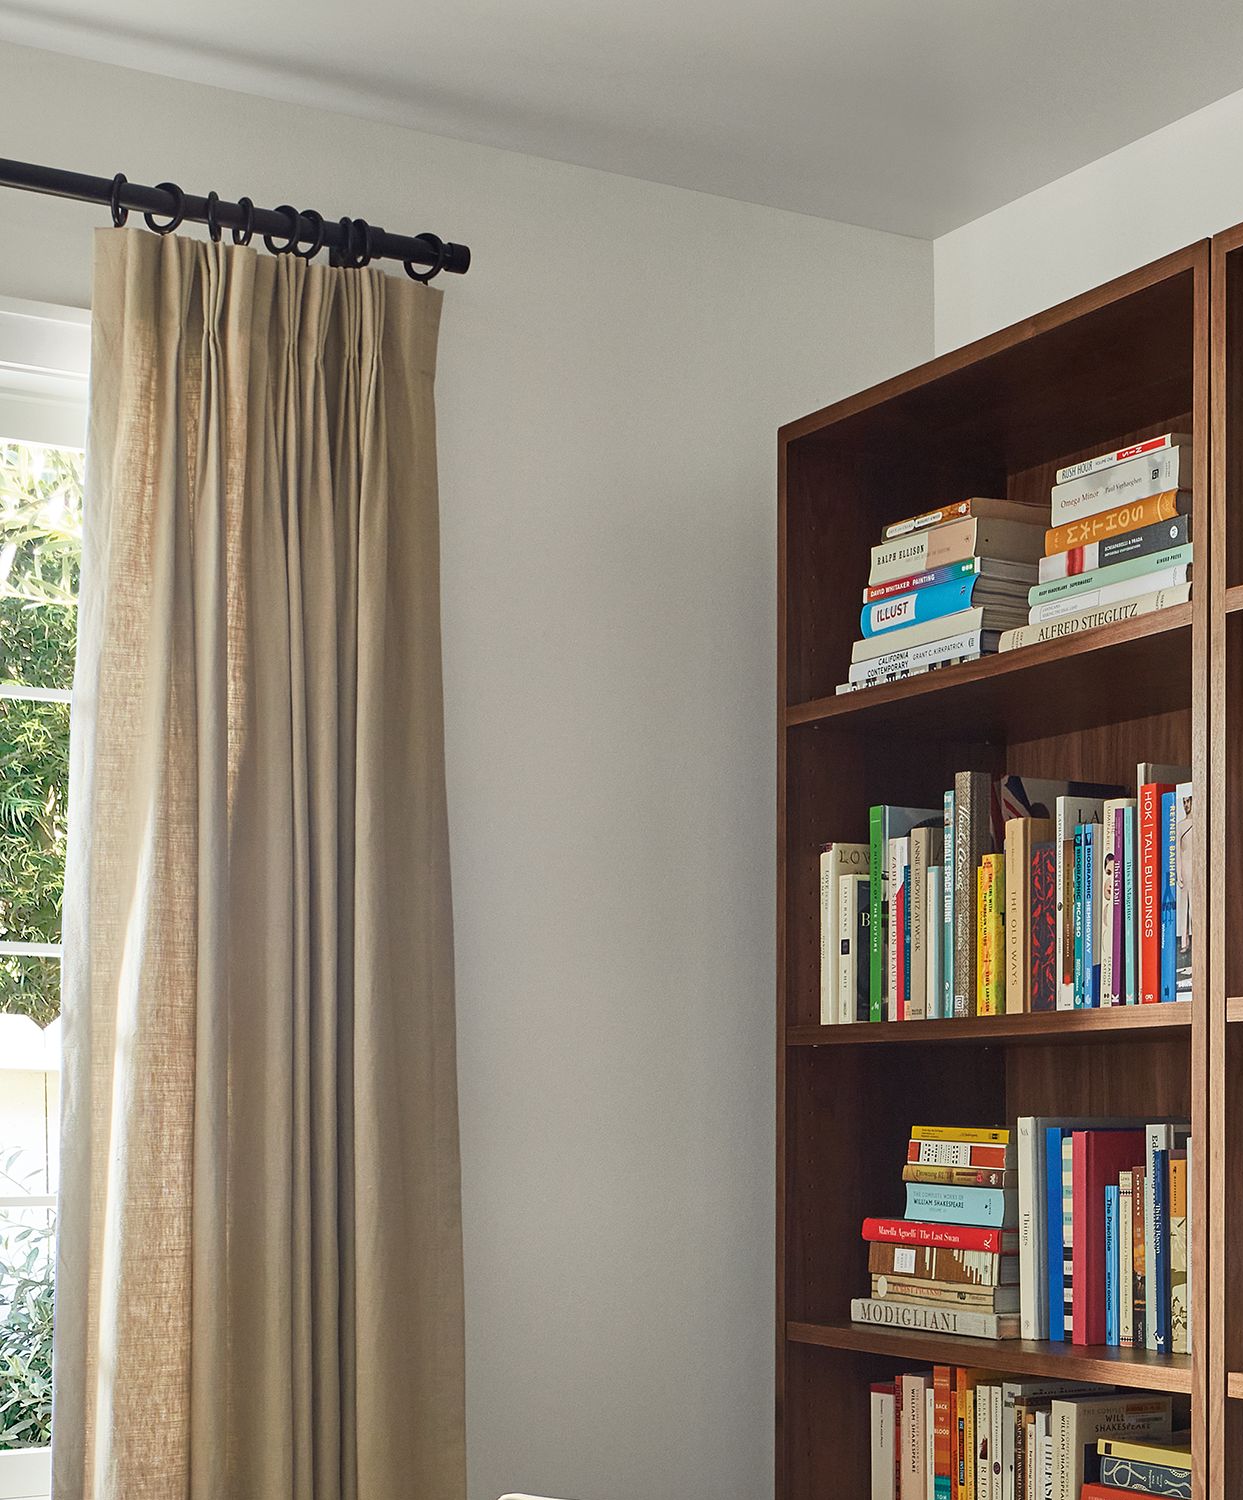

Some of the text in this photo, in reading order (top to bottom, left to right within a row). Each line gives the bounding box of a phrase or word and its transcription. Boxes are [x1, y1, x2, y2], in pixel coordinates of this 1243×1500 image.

[1061, 460, 1093, 480] RUSH HOUR
[1060, 477, 1143, 509] Omega Minor Paul Verhaeghen
[877, 551, 897, 566] RALPH
[898, 544, 925, 560] ELLISON
[870, 573, 935, 598] DAVID WHITAKER PAINTING
[876, 601, 909, 623] ILLUST
[1037, 619, 1079, 642] ALFRED
[1081, 603, 1138, 631] STIEGLITZ
[867, 661, 909, 678] CONTEMPORARY
[878, 651, 909, 666] CALIFORNIA
[1143, 791, 1153, 938] HOK TALL BUILDINGS
[1168, 845, 1176, 887] BANHAM
[944, 833, 952, 924] SMALL SPACE LIVING
[914, 911, 921, 923] AT
[1010, 919, 1018, 945] OLD
[1010, 950, 1018, 987] WAYS
[913, 1198, 964, 1209] WILLIAM SHAKESPEARE
[878, 1225, 960, 1243] Marella Agnelli The Last Swan
[1022, 1210, 1031, 1247] Things
[860, 1302, 958, 1332] MODIGLIANI
